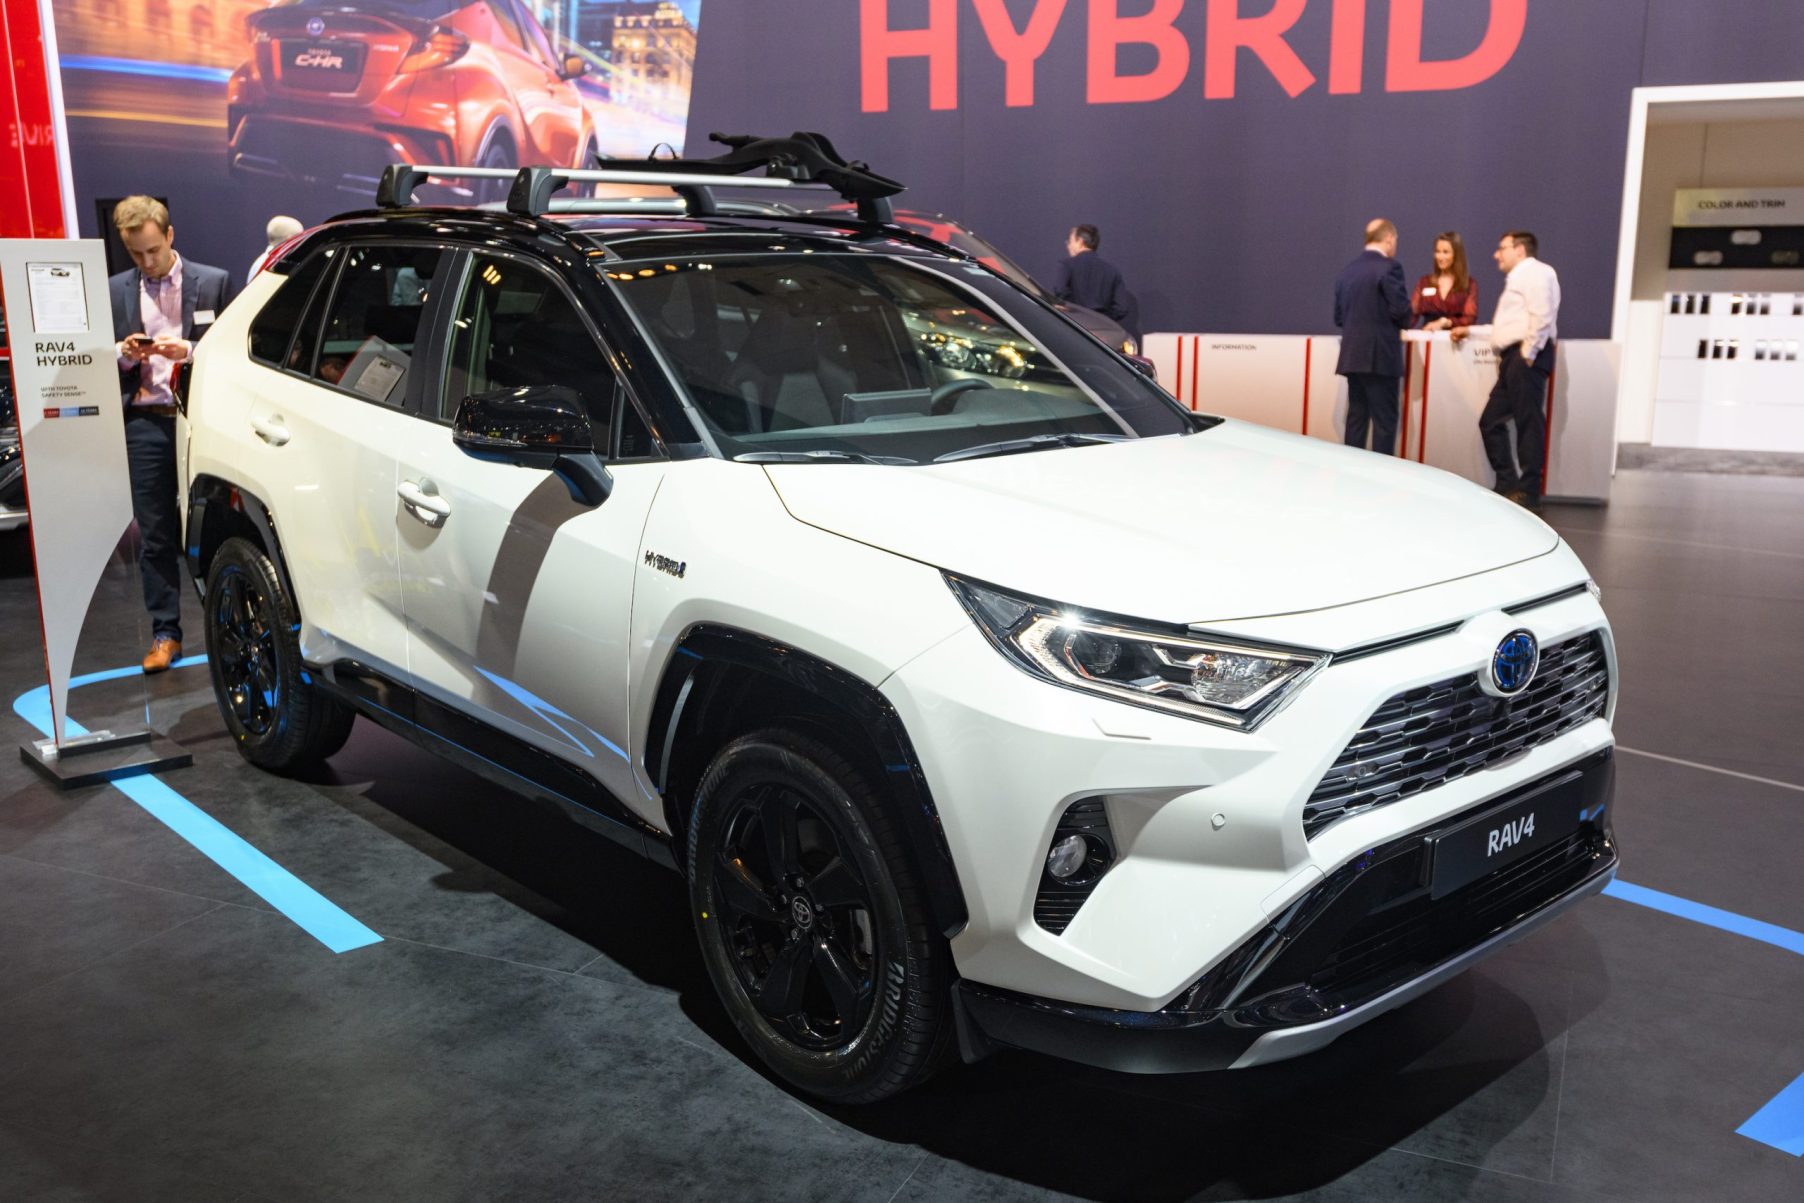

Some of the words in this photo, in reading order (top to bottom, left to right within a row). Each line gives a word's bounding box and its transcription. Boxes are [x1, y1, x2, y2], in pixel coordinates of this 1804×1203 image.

[861, 0, 1527, 112] HYBRID
[1698, 200, 1734, 209] COLOR
[1735, 200, 1759, 208] AND
[35, 342, 75, 353] RAV4
[37, 355, 93, 366] HYBRID
[645, 550, 680, 576] HYBRID
[1488, 812, 1535, 857] RAV4
